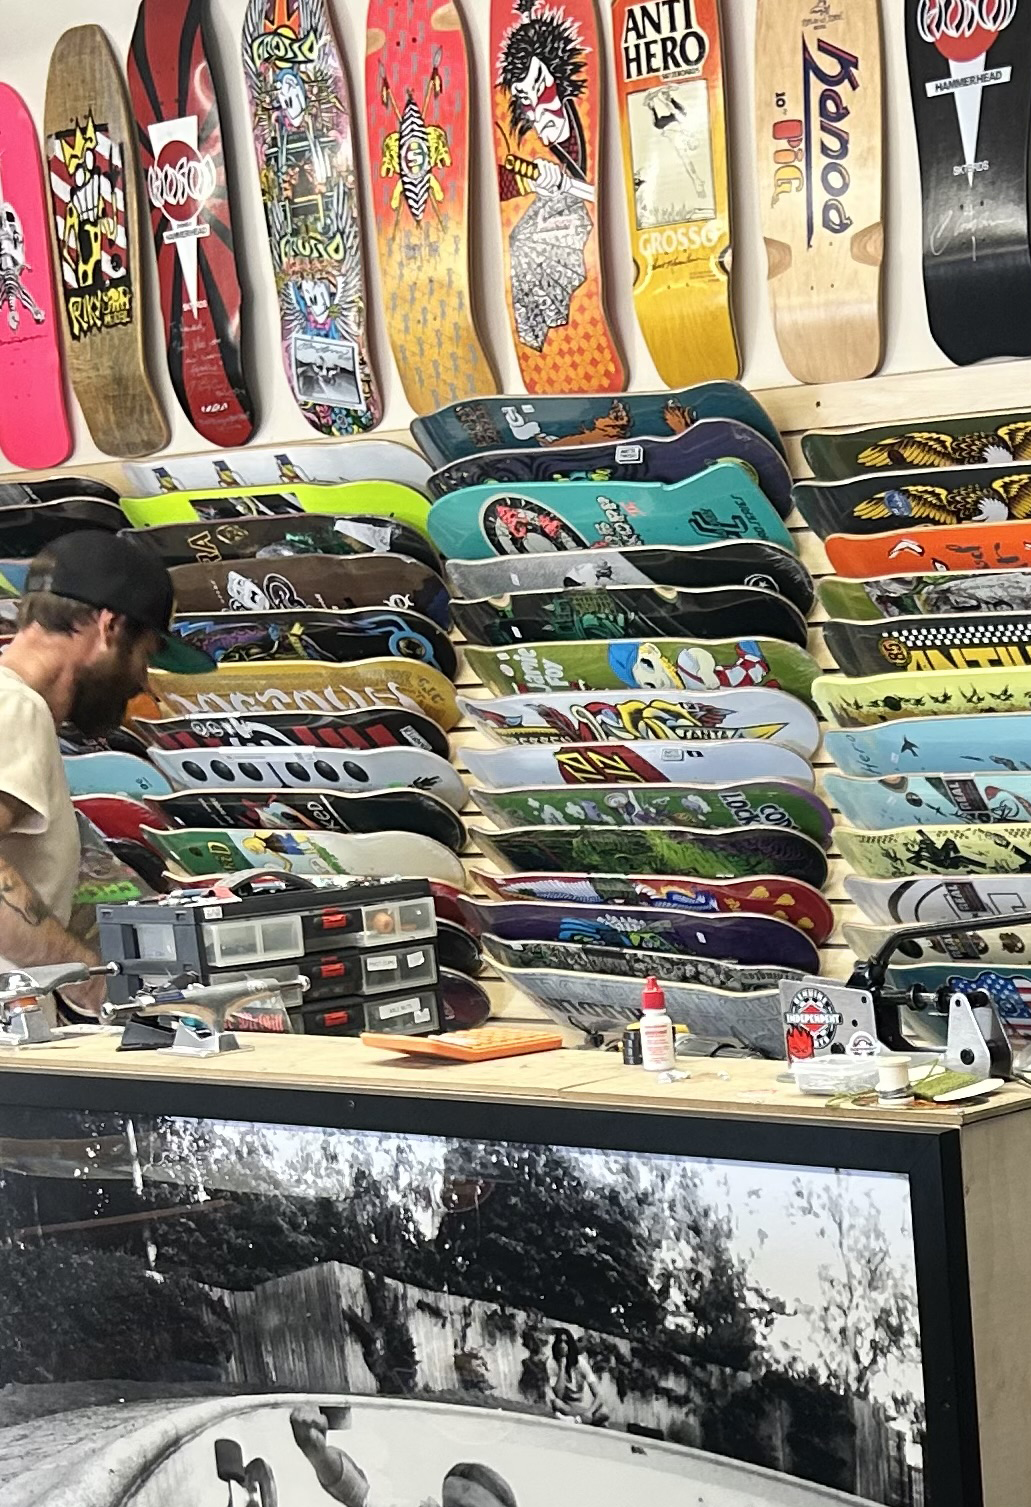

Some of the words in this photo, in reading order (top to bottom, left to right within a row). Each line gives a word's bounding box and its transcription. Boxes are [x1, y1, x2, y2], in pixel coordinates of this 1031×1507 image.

[624, 0, 693, 43] ANTI
[624, 31, 706, 79] HERO
[934, 70, 1003, 93] HAMMERHEAD
[786, 1012, 841, 1024] INDEPENDENT
